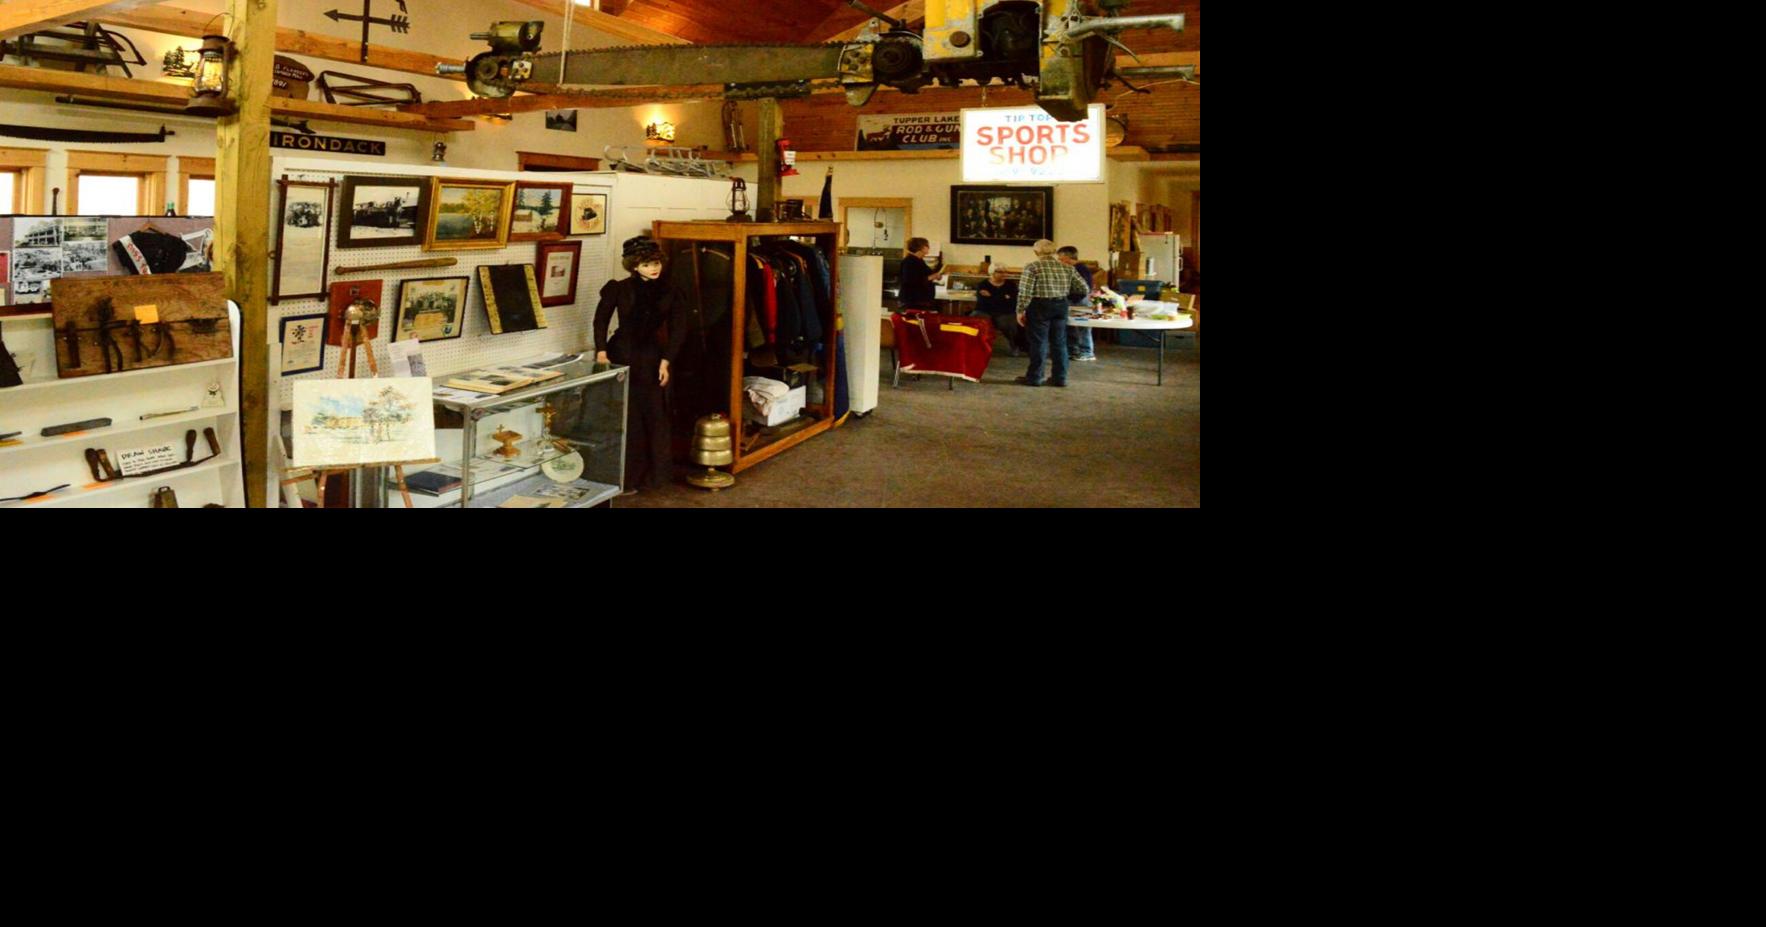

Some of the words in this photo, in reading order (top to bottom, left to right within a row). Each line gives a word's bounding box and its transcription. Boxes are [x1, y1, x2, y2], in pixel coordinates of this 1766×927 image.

[894, 115, 930, 124] TUPPER
[934, 115, 960, 123] LAKE
[1005, 115, 1025, 123] TIP
[895, 125, 924, 134] ROD
[925, 125, 932, 133] &
[902, 134, 938, 143] CLUB
[976, 123, 1090, 146] SPORTS
[990, 144, 1069, 166] SHOP
